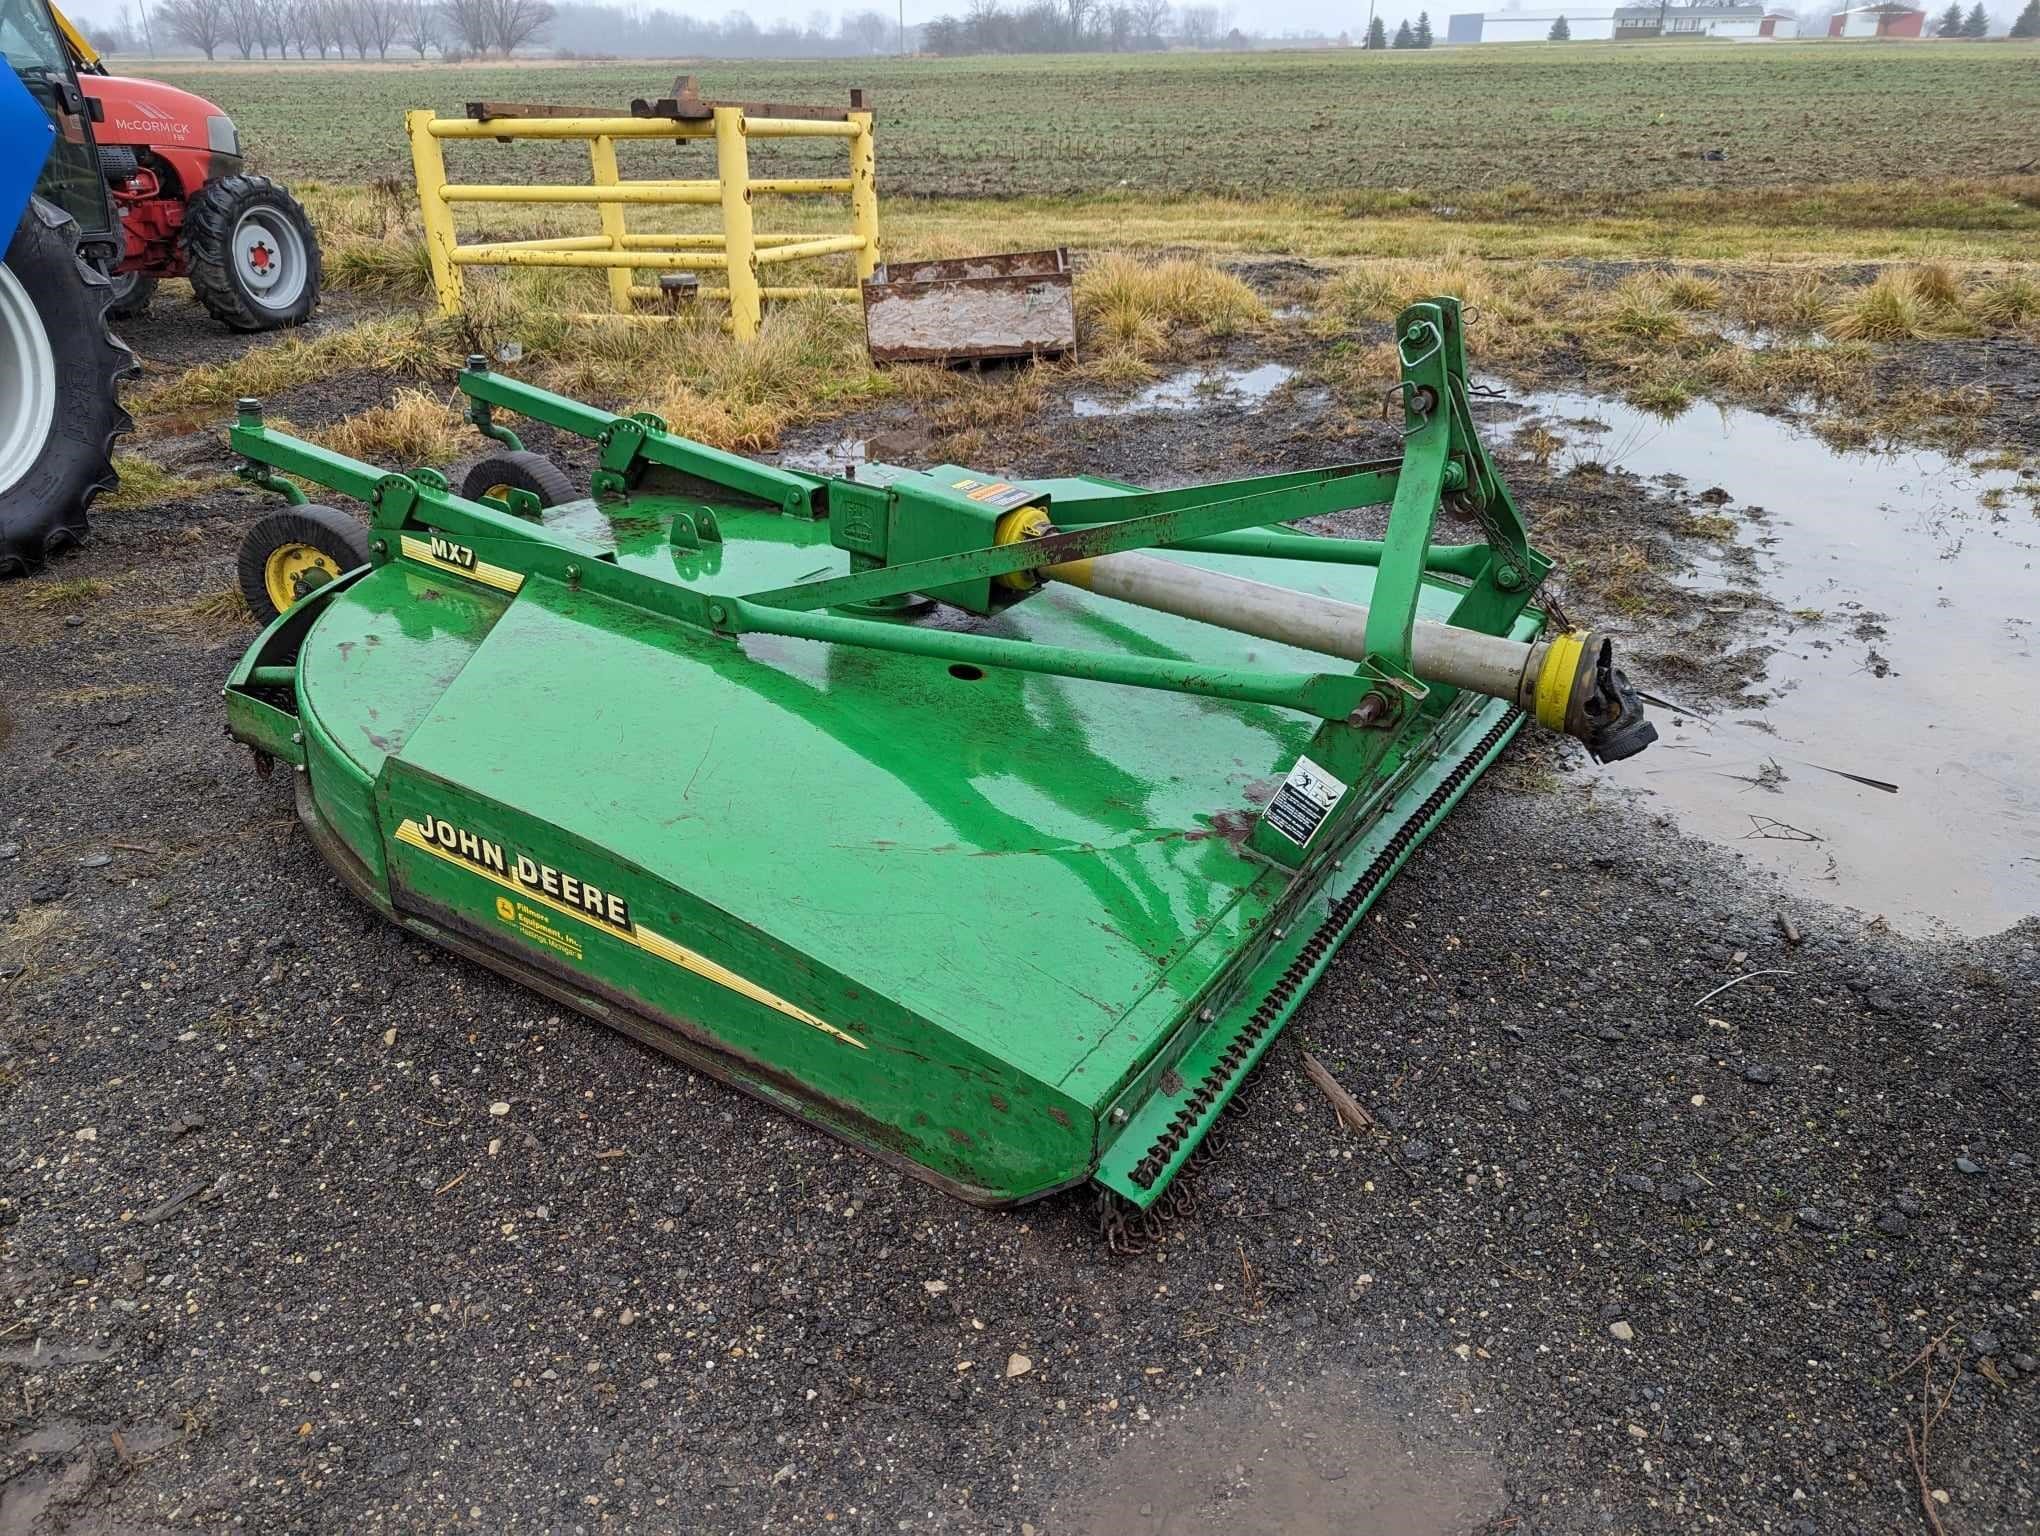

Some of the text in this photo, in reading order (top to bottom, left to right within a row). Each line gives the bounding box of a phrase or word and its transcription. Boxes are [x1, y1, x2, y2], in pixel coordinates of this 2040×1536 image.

[115, 119, 190, 134] McCORMICK
[431, 536, 475, 568] MX7
[418, 814, 629, 929] JOHN DEERE
